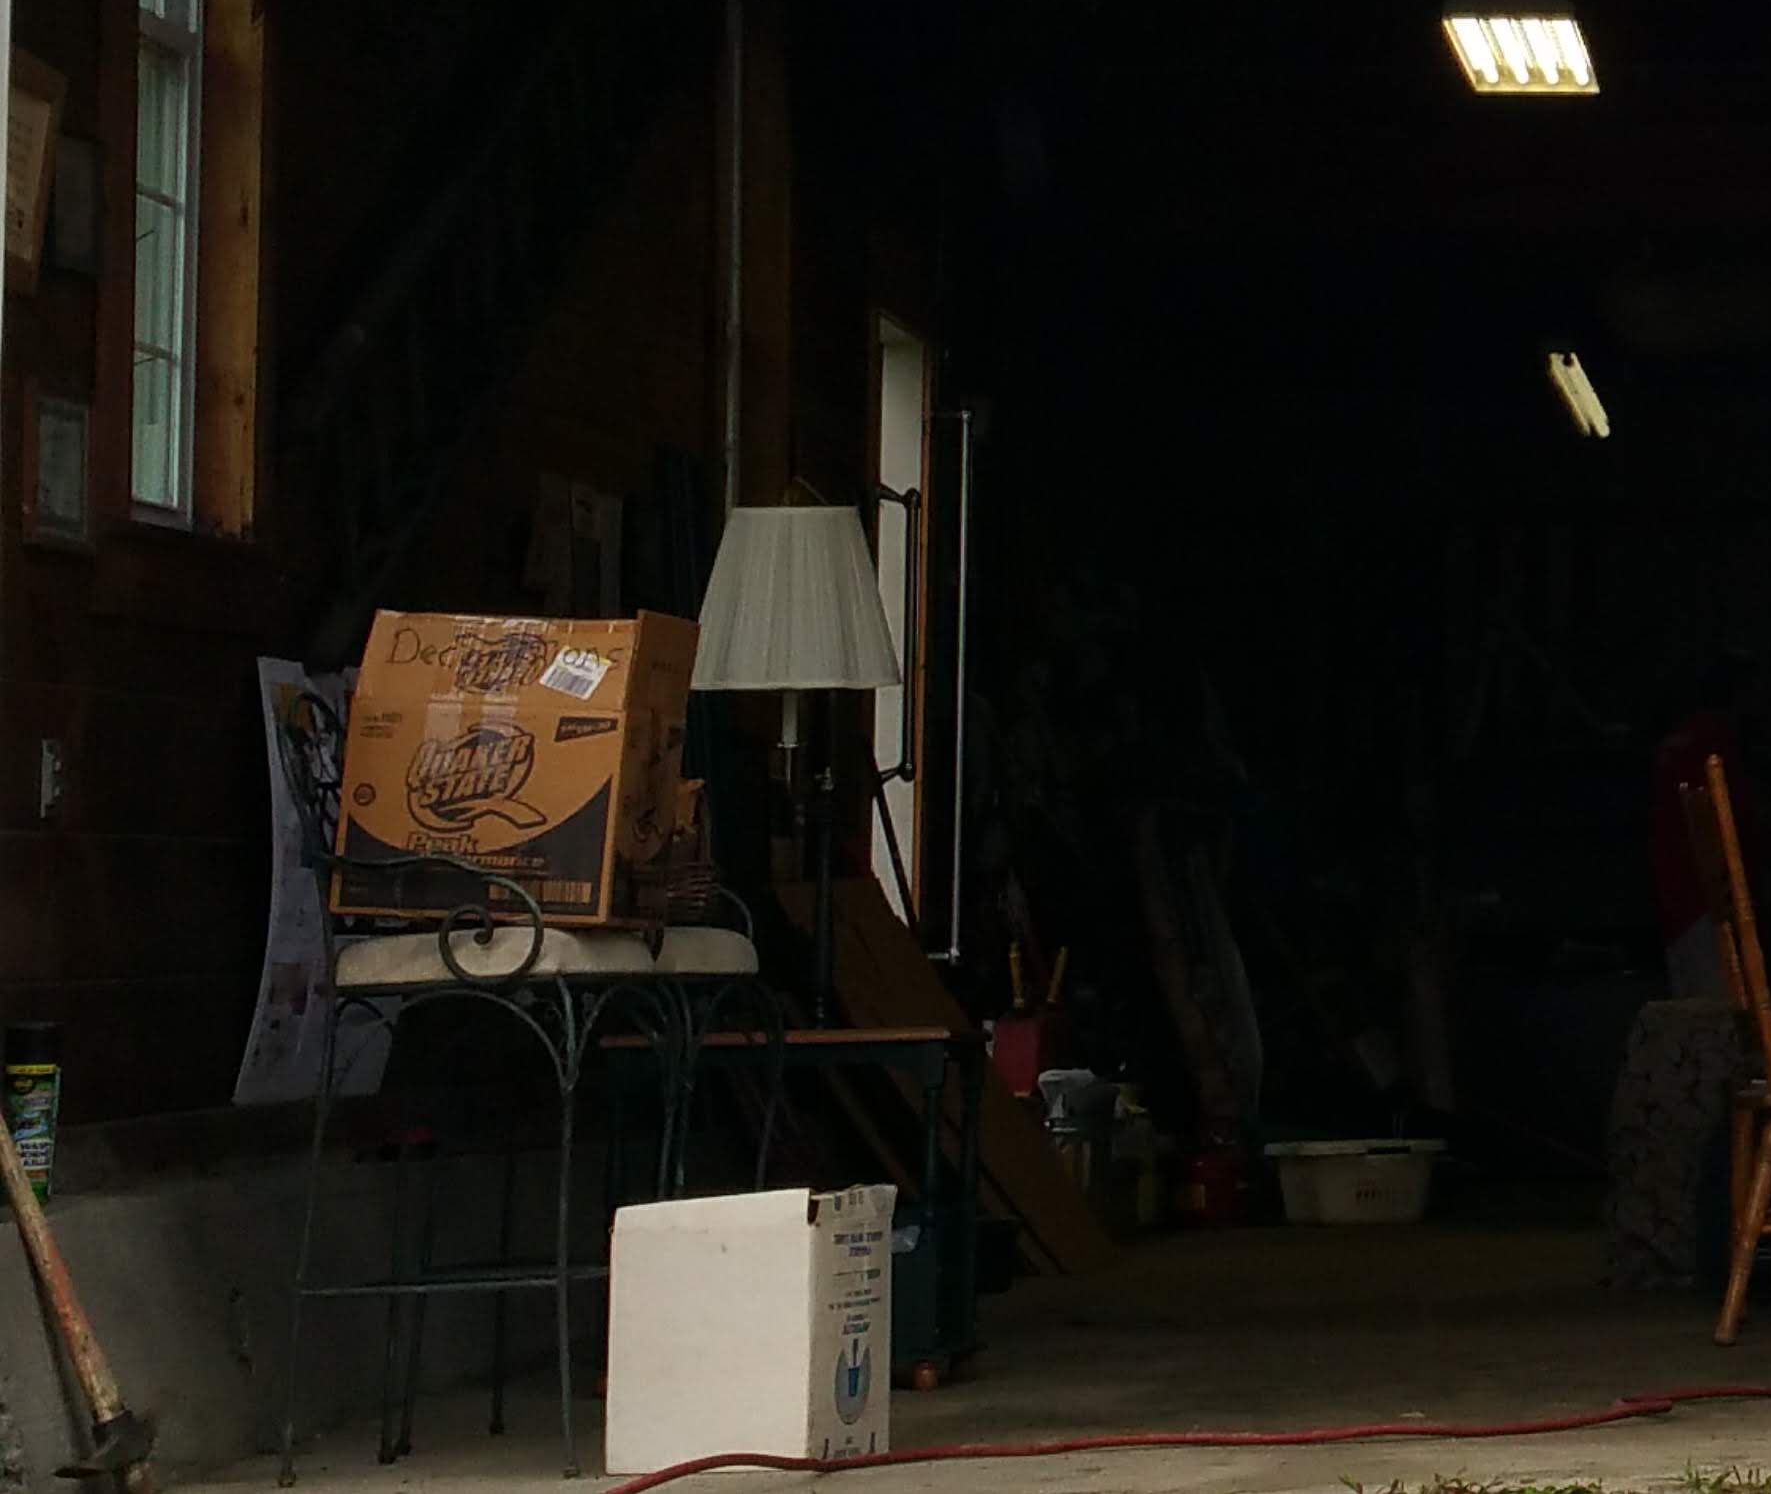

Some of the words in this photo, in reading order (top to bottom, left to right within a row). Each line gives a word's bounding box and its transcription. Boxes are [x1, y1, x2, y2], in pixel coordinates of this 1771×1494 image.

[407, 731, 535, 791] QUAKER
[420, 764, 513, 808] STATE
[410, 832, 479, 855] Peak
